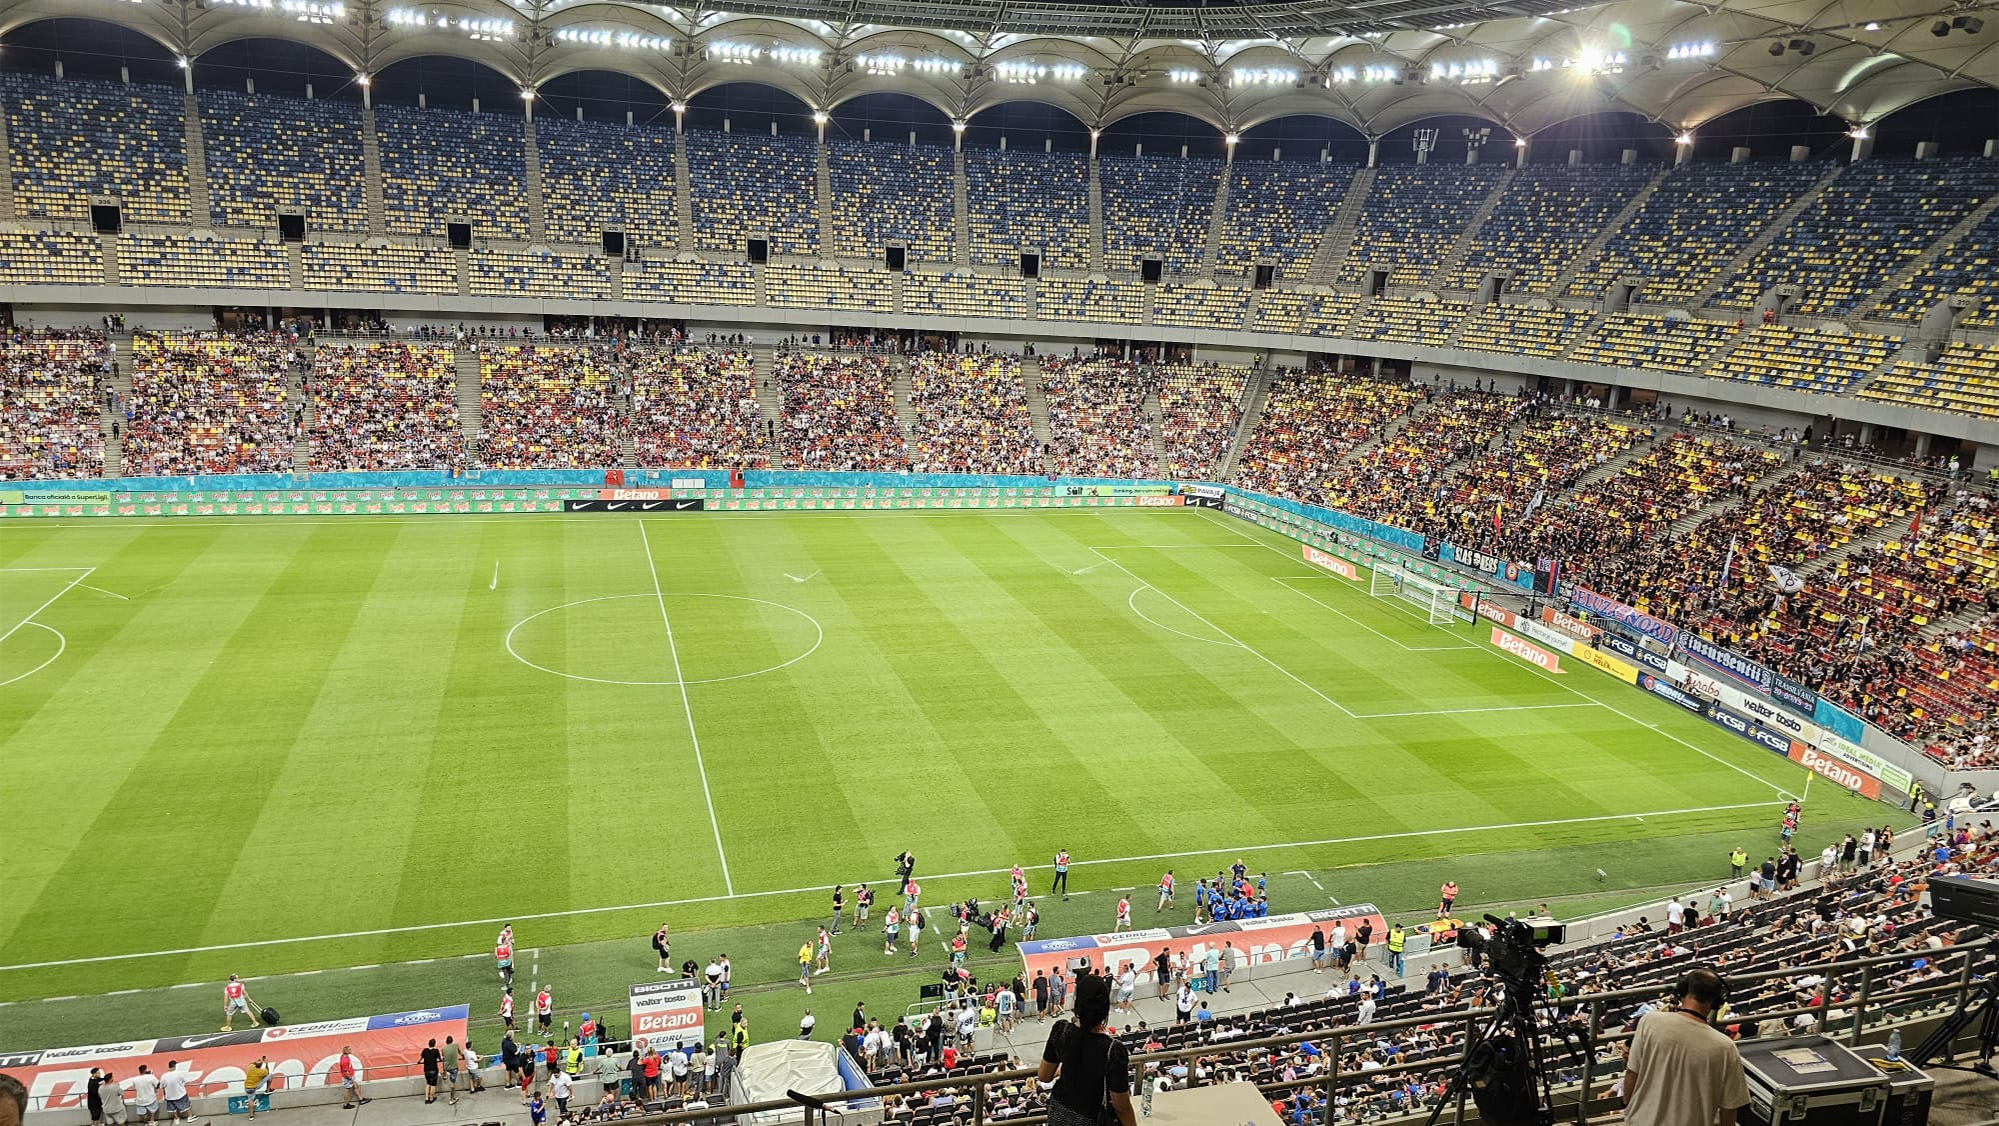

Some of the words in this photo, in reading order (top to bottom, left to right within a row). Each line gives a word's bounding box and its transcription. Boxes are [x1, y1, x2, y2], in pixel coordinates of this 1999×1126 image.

[614, 490, 659, 500] Betano
[1140, 496, 1175, 506] Betano
[1310, 549, 1348, 576] Betano
[1552, 612, 1591, 638] Betano
[1626, 611, 1674, 643] NORD
[1499, 632, 1548, 666] Betano
[1611, 638, 1634, 655] FCSB
[1643, 653, 1667, 670] FCSB
[1656, 683, 1685, 701] CEDRU
[1715, 711, 1746, 732] FCSB
[1744, 699, 1775, 718] walter
[1776, 712, 1801, 732] tosto
[1756, 731, 1789, 752] FCSB
[1801, 748, 1862, 790] Betano
[1310, 905, 1375, 920] BIGOTTI
[634, 980, 694, 994] BIGOTTI
[636, 997, 663, 1007] walter
[664, 995, 687, 1004] tosto
[288, 1023, 340, 1033] CEDRU
[639, 1012, 698, 1031] Betano
[649, 1034, 683, 1044] CEDRU
[46, 1048, 93, 1059] walter
[94, 1045, 134, 1054] tosto
